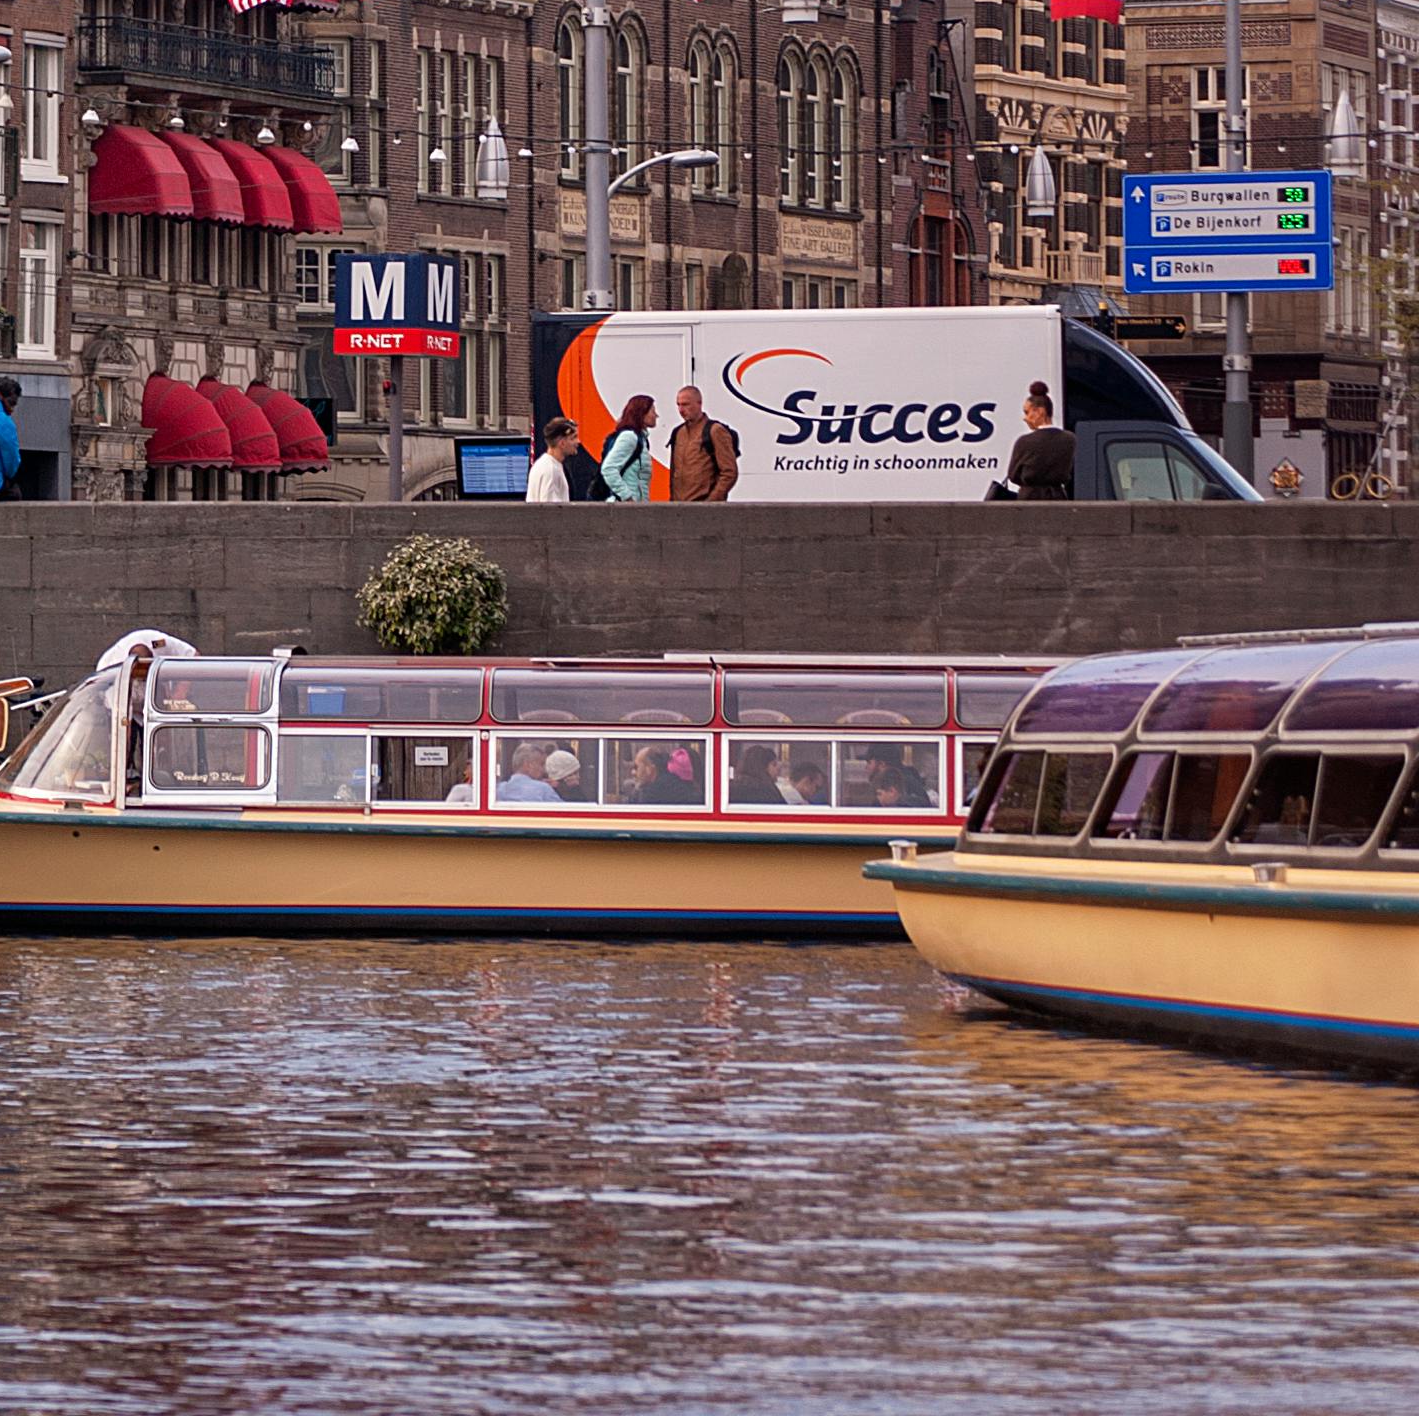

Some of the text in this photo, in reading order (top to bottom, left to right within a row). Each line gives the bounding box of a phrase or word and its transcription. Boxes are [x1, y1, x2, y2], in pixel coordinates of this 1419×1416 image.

[1191, 190, 1270, 204] Burgwallen
[1174, 217, 1191, 229] De
[1197, 215, 1261, 231] Bijenkorf
[1174, 262, 1214, 274] Rokin
[351, 261, 405, 321] M
[427, 262, 454, 324] M
[775, 390, 997, 445] Succes
[774, 454, 998, 474] Krachtig in schoonmaken
